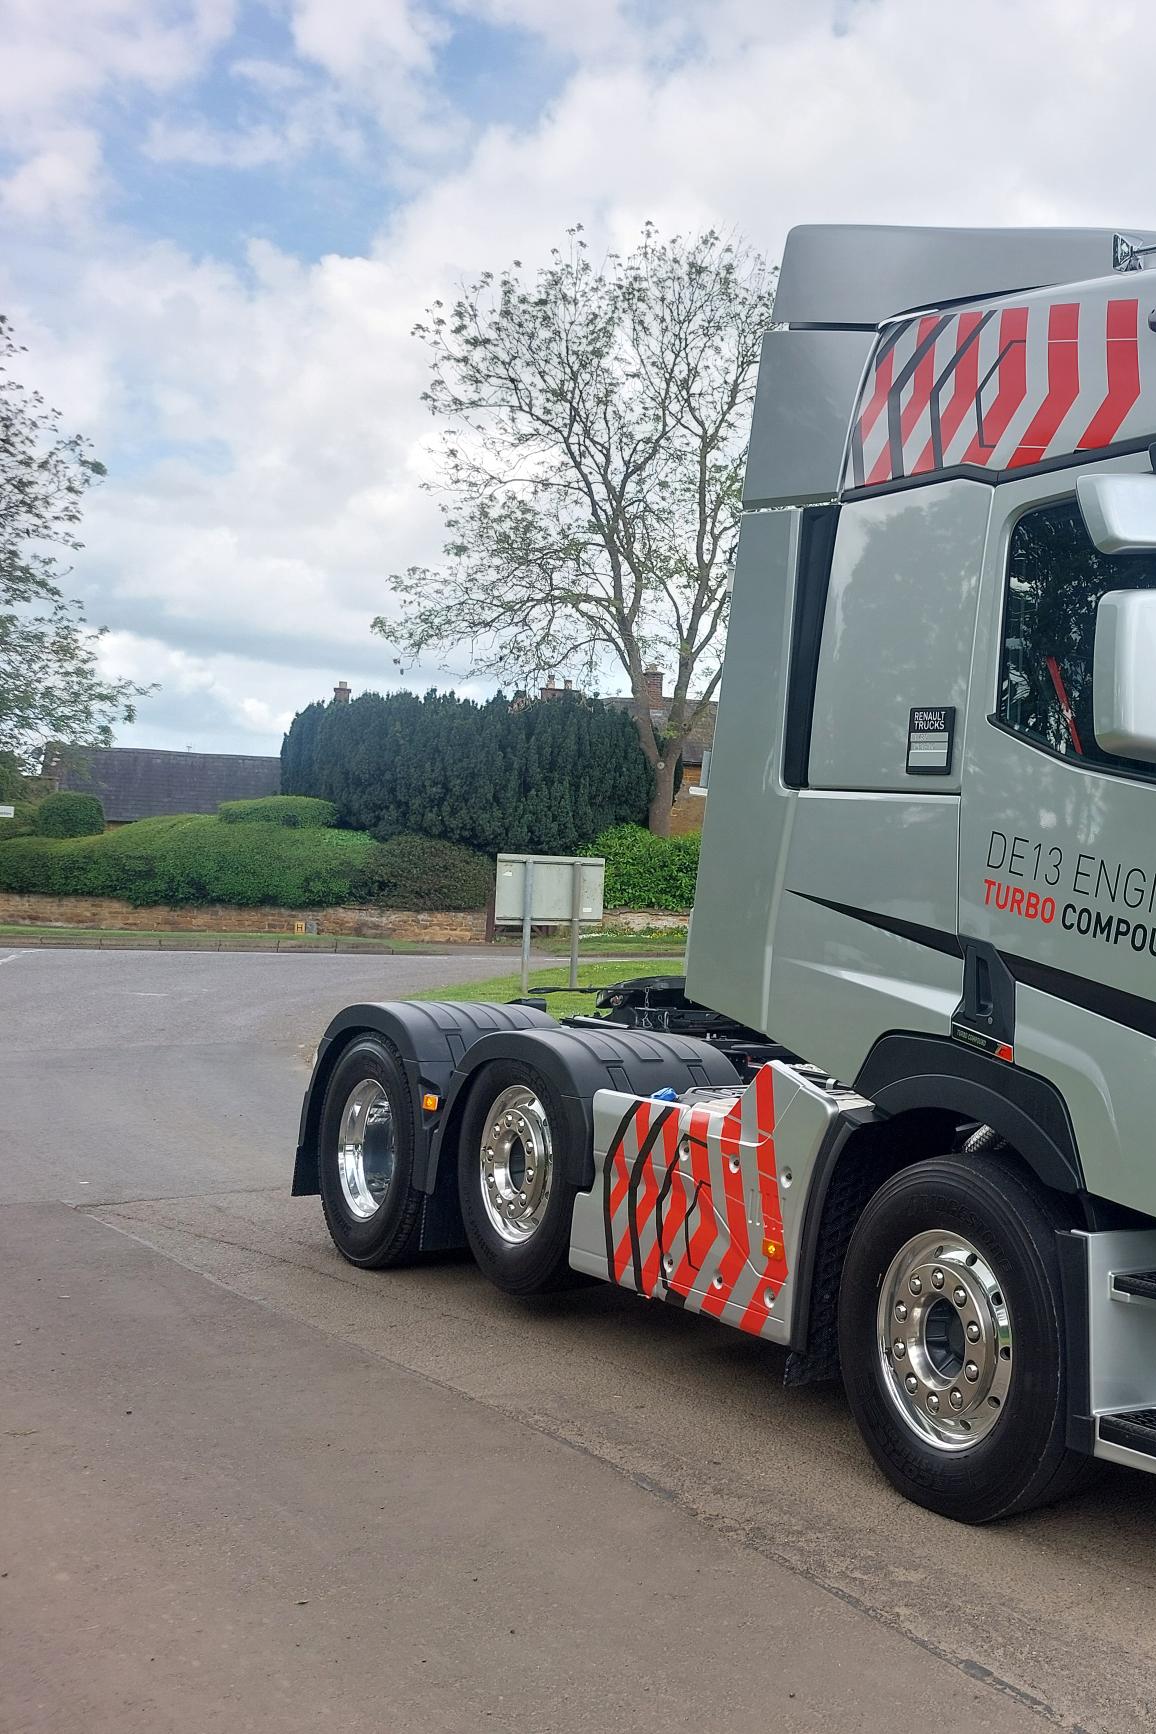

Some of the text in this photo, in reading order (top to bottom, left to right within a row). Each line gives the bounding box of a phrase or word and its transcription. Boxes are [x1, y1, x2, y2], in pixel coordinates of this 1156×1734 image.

[914, 711, 946, 721] RENAULT
[914, 720, 945, 730] TRUCKS
[986, 830, 1063, 886] DE13
[984, 879, 1056, 925] TURBO
